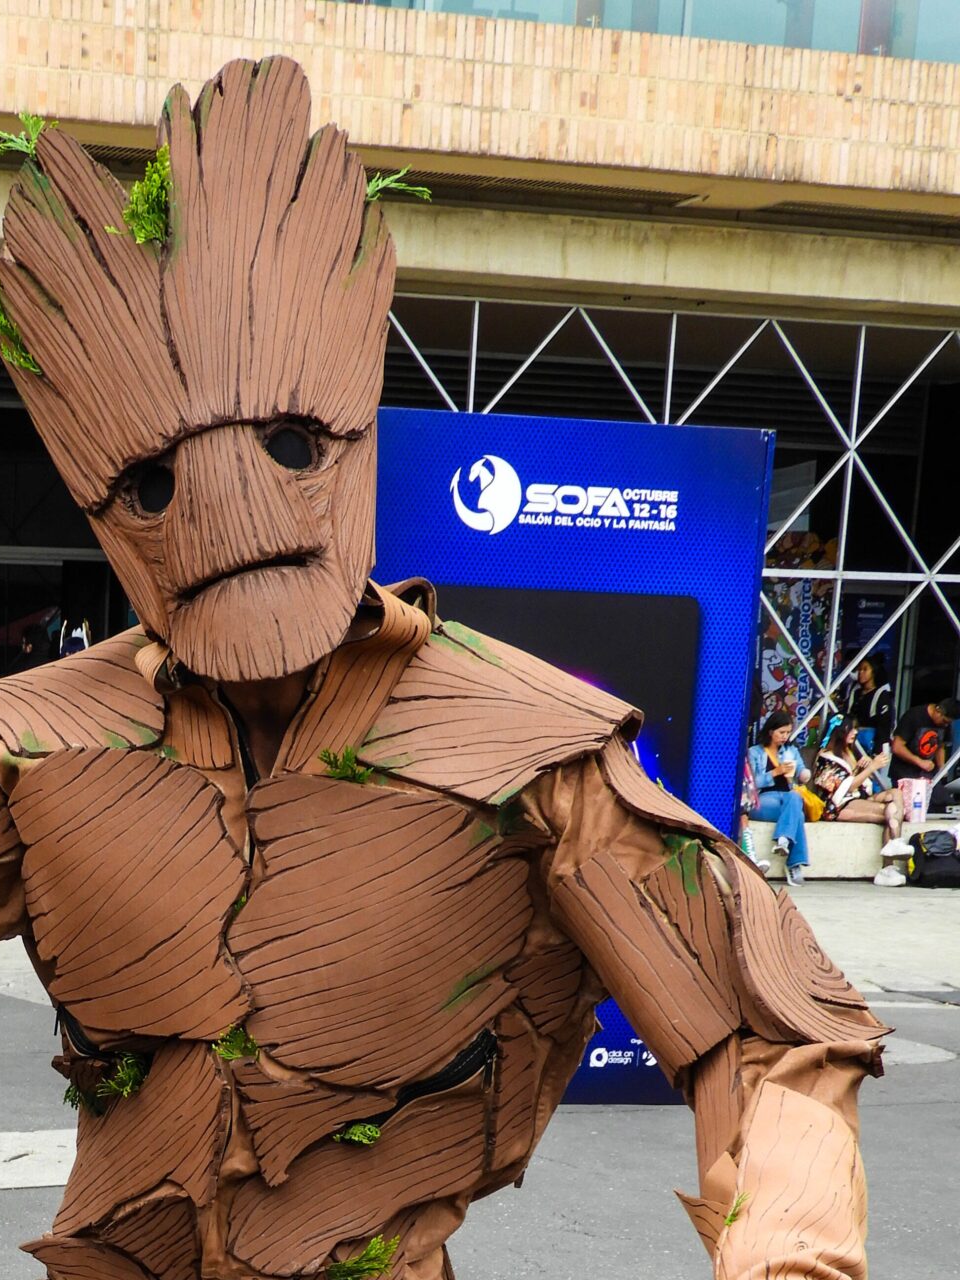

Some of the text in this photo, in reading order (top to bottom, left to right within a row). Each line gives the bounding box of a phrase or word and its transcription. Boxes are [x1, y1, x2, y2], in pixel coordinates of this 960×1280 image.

[522, 483, 631, 517] SOFA
[623, 488, 679, 502] OCTUBRE
[518, 513, 676, 531] SALÓN DEL OCIO Y LA FANTASÍA
[607, 1057, 632, 1066] design
